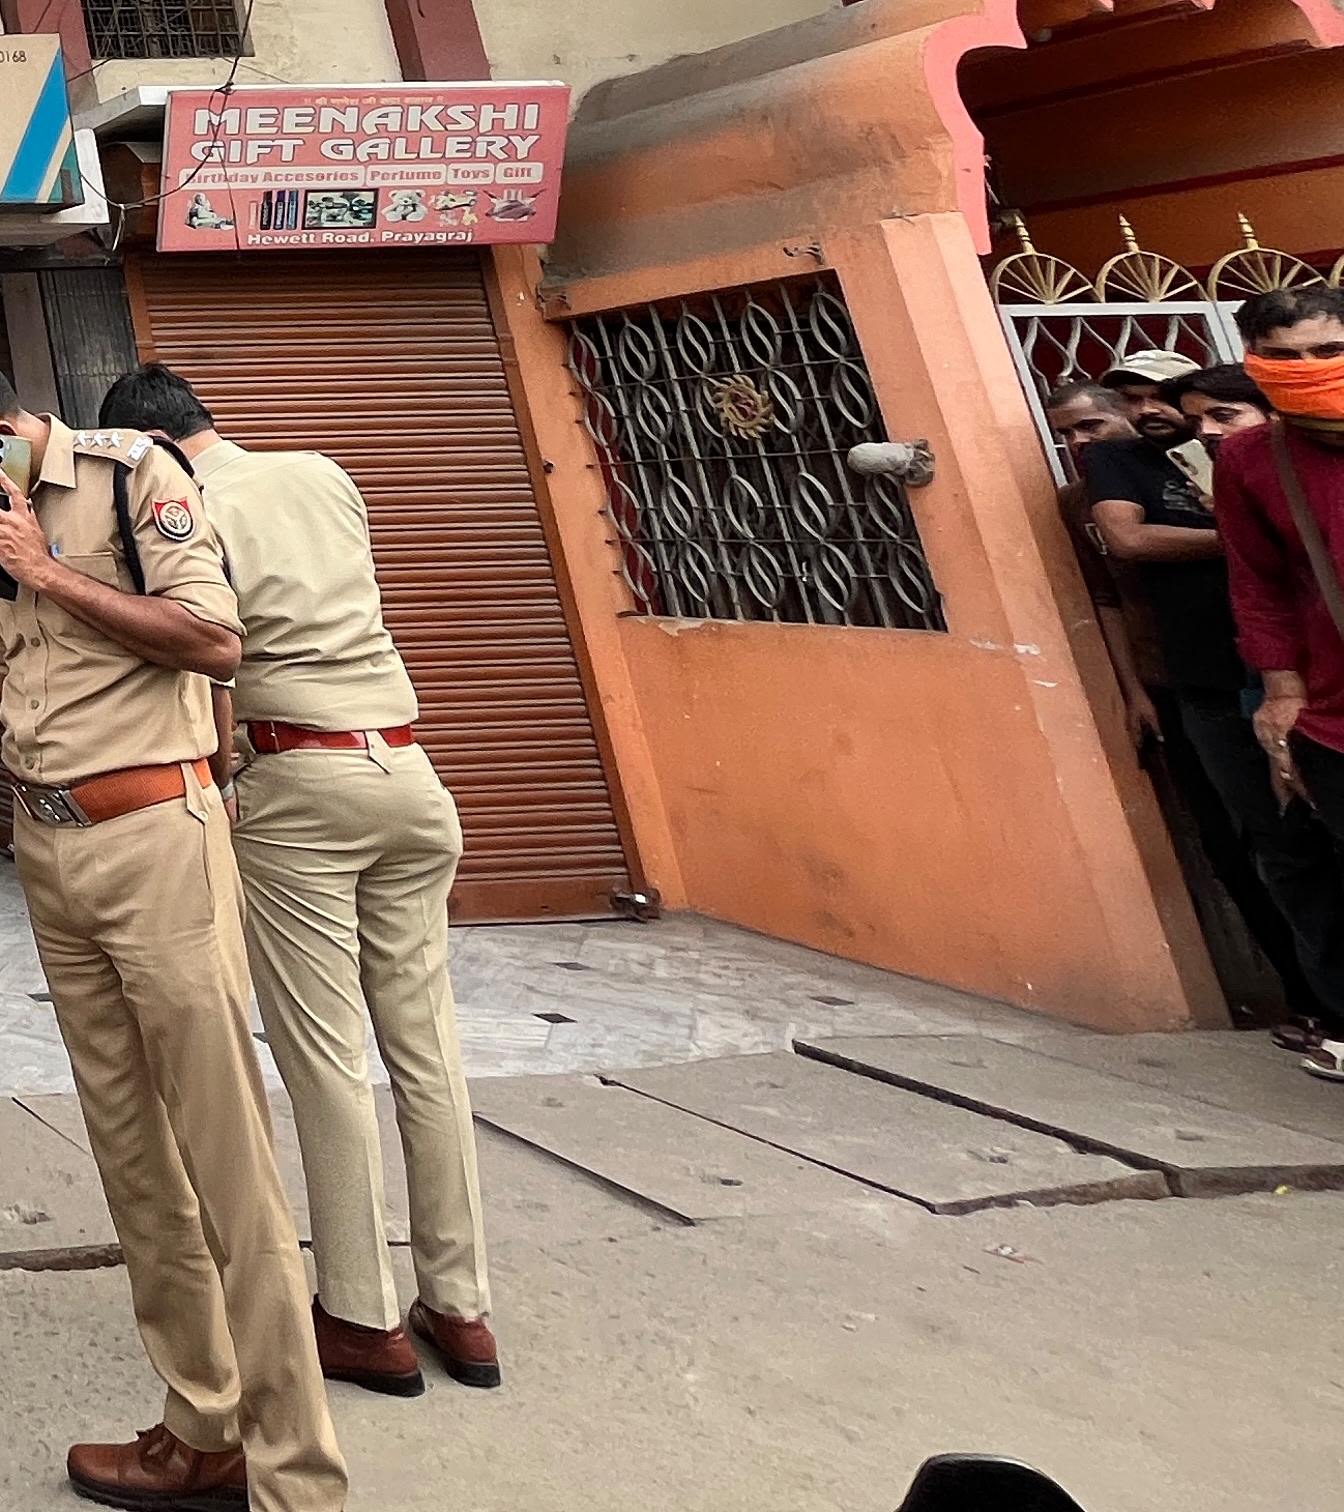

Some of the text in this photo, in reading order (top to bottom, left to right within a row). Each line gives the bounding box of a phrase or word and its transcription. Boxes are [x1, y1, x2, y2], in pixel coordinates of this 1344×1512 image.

[193, 103, 540, 136] MEENAKSHI
[190, 134, 541, 166] GIFT GALLERY
[263, 170, 359, 184] Accesories
[370, 169, 443, 183] Perfume
[451, 167, 491, 181] Toys
[502, 165, 533, 180] Gift
[247, 231, 316, 246] Hewett
[381, 229, 473, 246] Prayagraj
